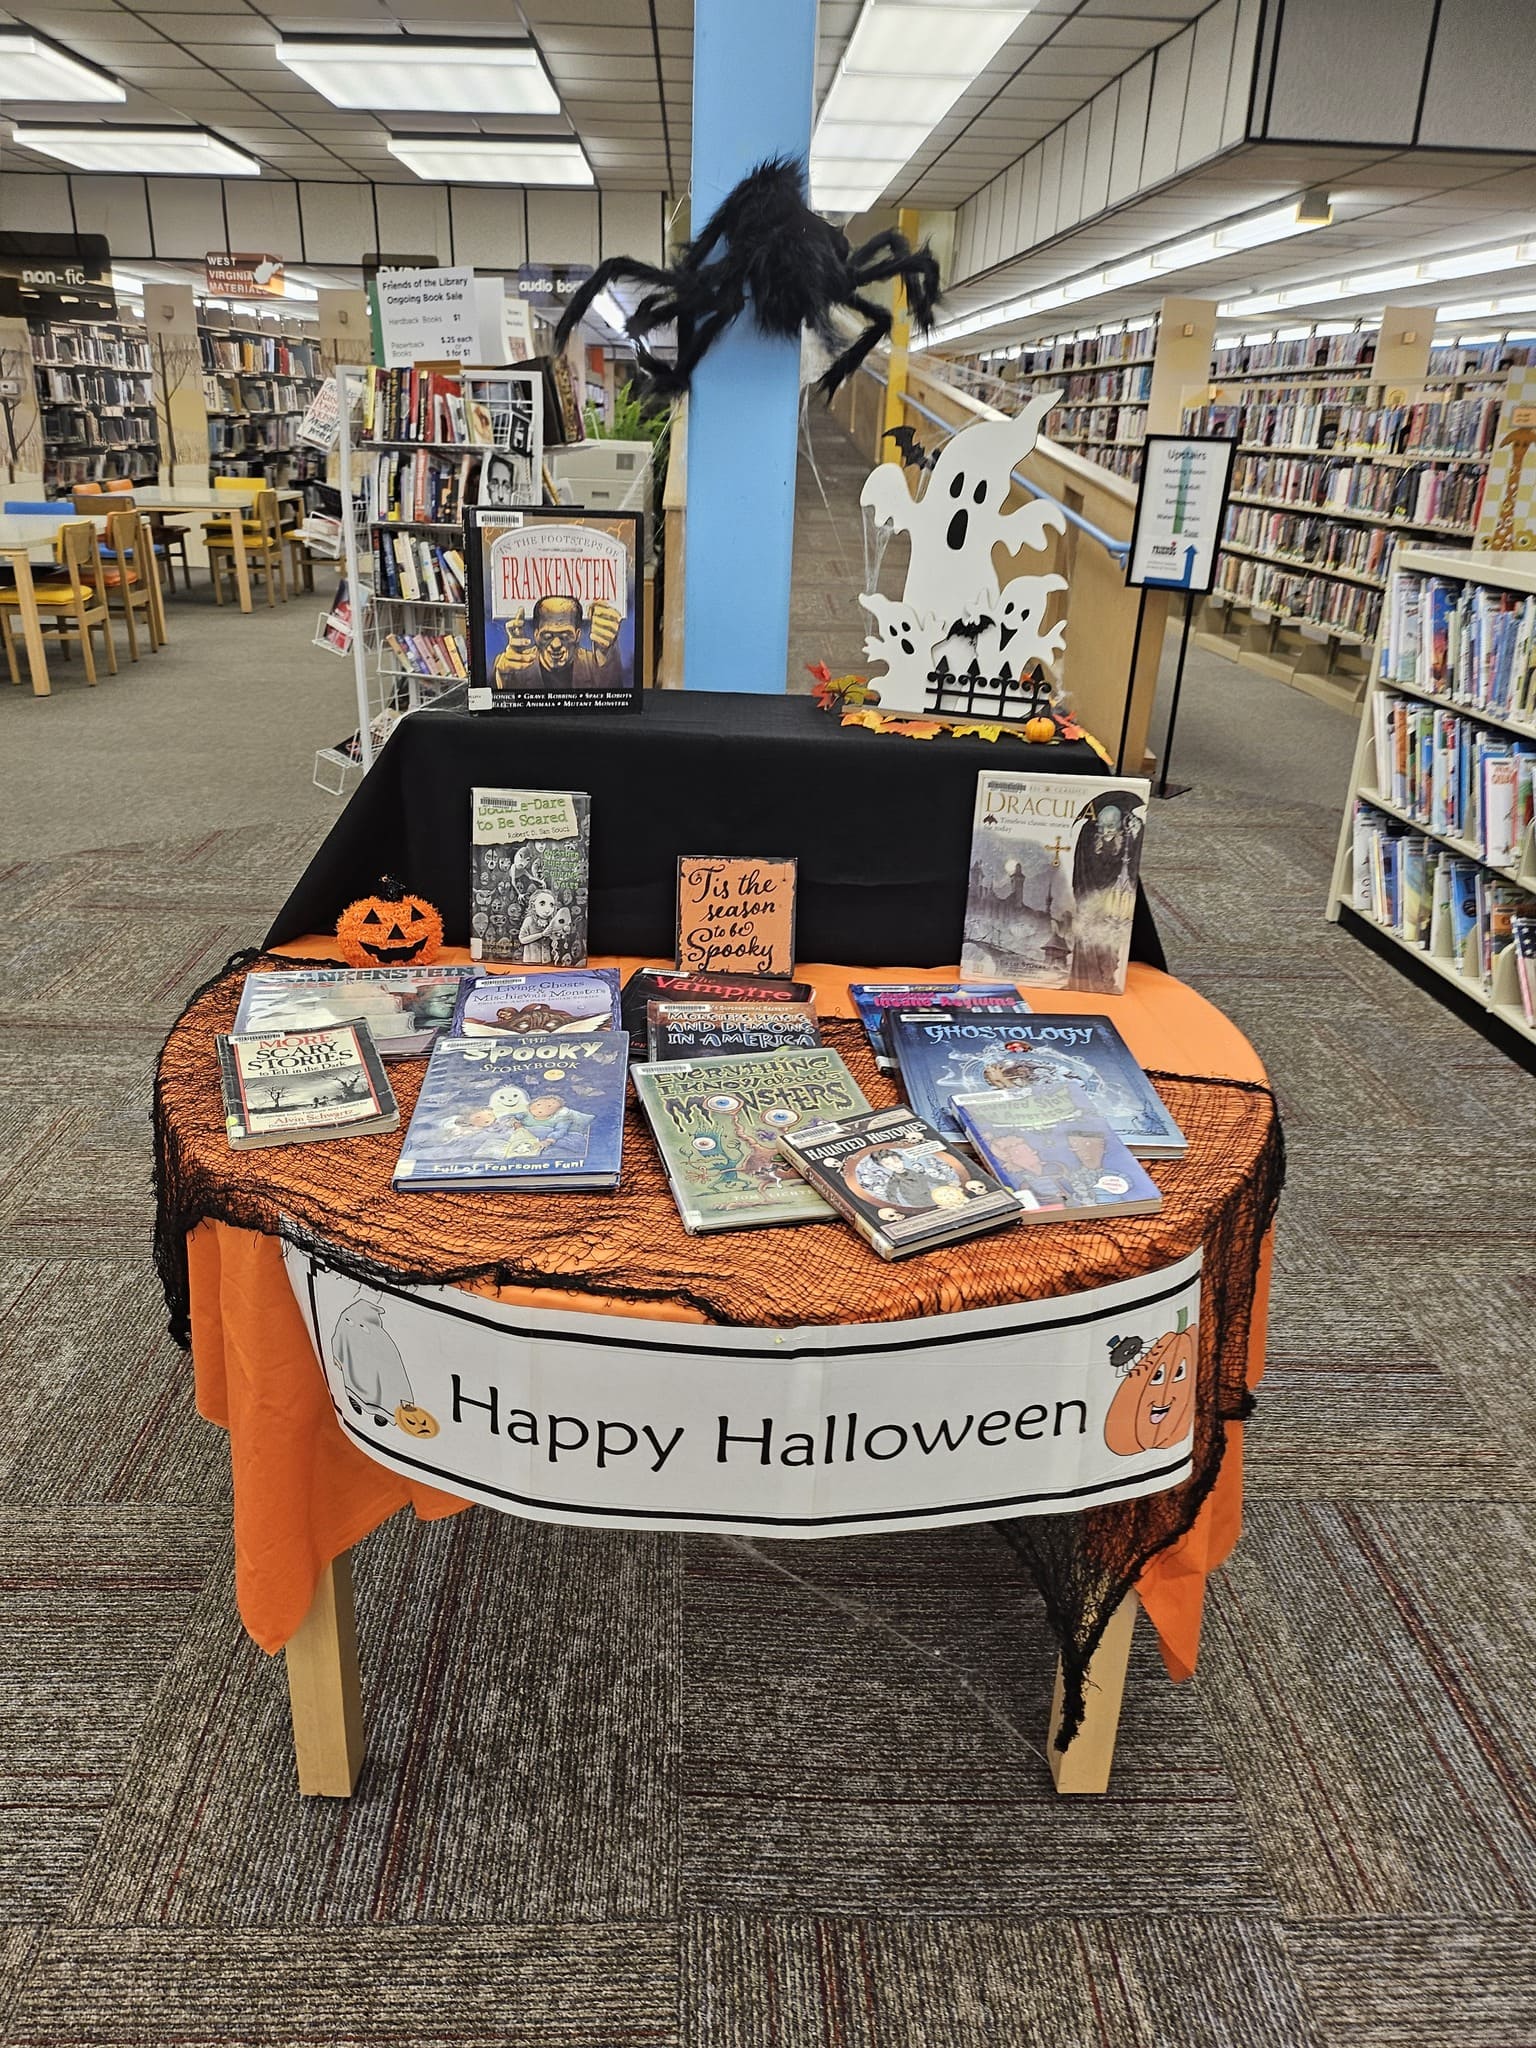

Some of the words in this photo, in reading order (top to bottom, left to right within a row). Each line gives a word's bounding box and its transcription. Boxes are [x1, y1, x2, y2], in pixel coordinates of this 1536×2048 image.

[207, 256, 237, 267] WEST
[22, 269, 87, 286] non-fic
[208, 270, 254, 281] VIRGINIA
[382, 280, 411, 291] Friends
[413, 279, 422, 288] of
[424, 279, 437, 288] the
[439, 277, 468, 287] Library
[209, 282, 268, 295] MATERIALS
[519, 279, 553, 293] audio
[387, 294, 421, 305] Ongoing
[423, 293, 444, 302] Book
[446, 291, 463, 301] Sale
[1168, 449, 1207, 462] Upstairs
[498, 543, 512, 555] IN
[514, 536, 538, 548] THE
[541, 535, 603, 550] FOOTSTEPS
[606, 545, 619, 557] OF
[502, 556, 618, 601] FRANKENSTEIN
[478, 798, 566, 816] Doube-Dare
[985, 792, 1098, 822] DRACULA
[477, 820, 494, 831] to
[497, 817, 515, 829] Be
[519, 810, 569, 827] Scared
[738, 869, 777, 895] the
[700, 901, 775, 922] season
[714, 925, 726, 938] to
[730, 921, 754, 937] be
[687, 928, 774, 972] Spooky
[496, 985, 537, 993] Living
[540, 980, 586, 989] Ghosts
[690, 975, 716, 983] The
[474, 992, 547, 1002] Mischievous
[550, 988, 607, 998] Monsters
[655, 976, 793, 1000] Vampire
[941, 995, 1016, 1009] Asylums
[666, 1021, 716, 1033] AND
[722, 1021, 815, 1034] DEMONS
[923, 1024, 1093, 1046] GHOSTOLOGY
[259, 1033, 334, 1049] MORE
[518, 1037, 546, 1045] THE
[667, 1033, 695, 1045] IN
[700, 1032, 816, 1048] AMERICA
[256, 1041, 338, 1060] SCARY
[463, 1042, 604, 1063] SPOOKY
[247, 1049, 354, 1071] STORIES
[322, 1061, 347, 1070] Dark
[479, 1061, 580, 1073] STORYBOOK
[656, 1056, 832, 1084] EVERYTHING
[658, 1084, 677, 1096] I
[682, 1077, 761, 1093] KNOW
[763, 1070, 845, 1086] about
[663, 1081, 854, 1133] MONSTERS
[274, 1114, 305, 1124] Alvin
[306, 1108, 354, 1121] Schwartz
[805, 1137, 867, 1161] HAUNTED
[867, 1121, 928, 1145] HISTORIES
[433, 1164, 457, 1173] Full
[462, 1164, 479, 1173] of
[484, 1161, 550, 1172] Fearsome
[554, 1159, 585, 1169] Fun!
[448, 1372, 685, 1470] Happy
[715, 1395, 1089, 1467] Halloween
